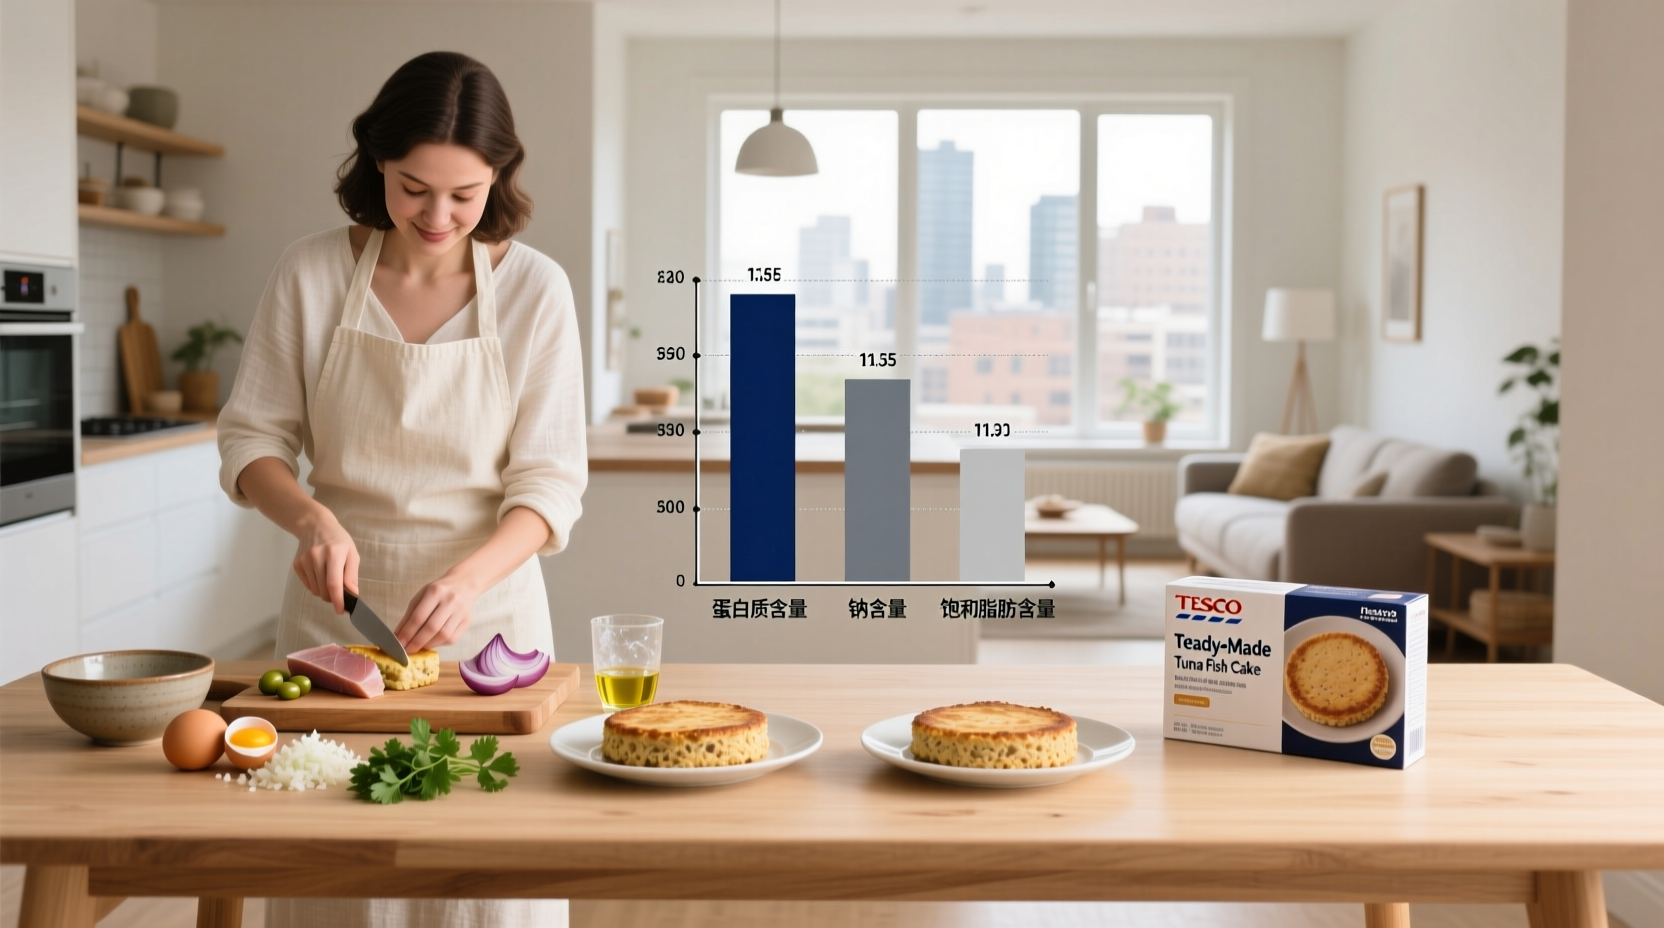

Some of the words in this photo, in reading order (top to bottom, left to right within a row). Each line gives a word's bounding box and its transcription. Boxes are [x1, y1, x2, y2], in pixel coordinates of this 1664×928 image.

[1175, 594, 1243, 615] TESCO
[1174, 633, 1272, 657] Teady-Made
[1174, 655, 1203, 672] Tuna
[1230, 661, 1262, 676] Cake
